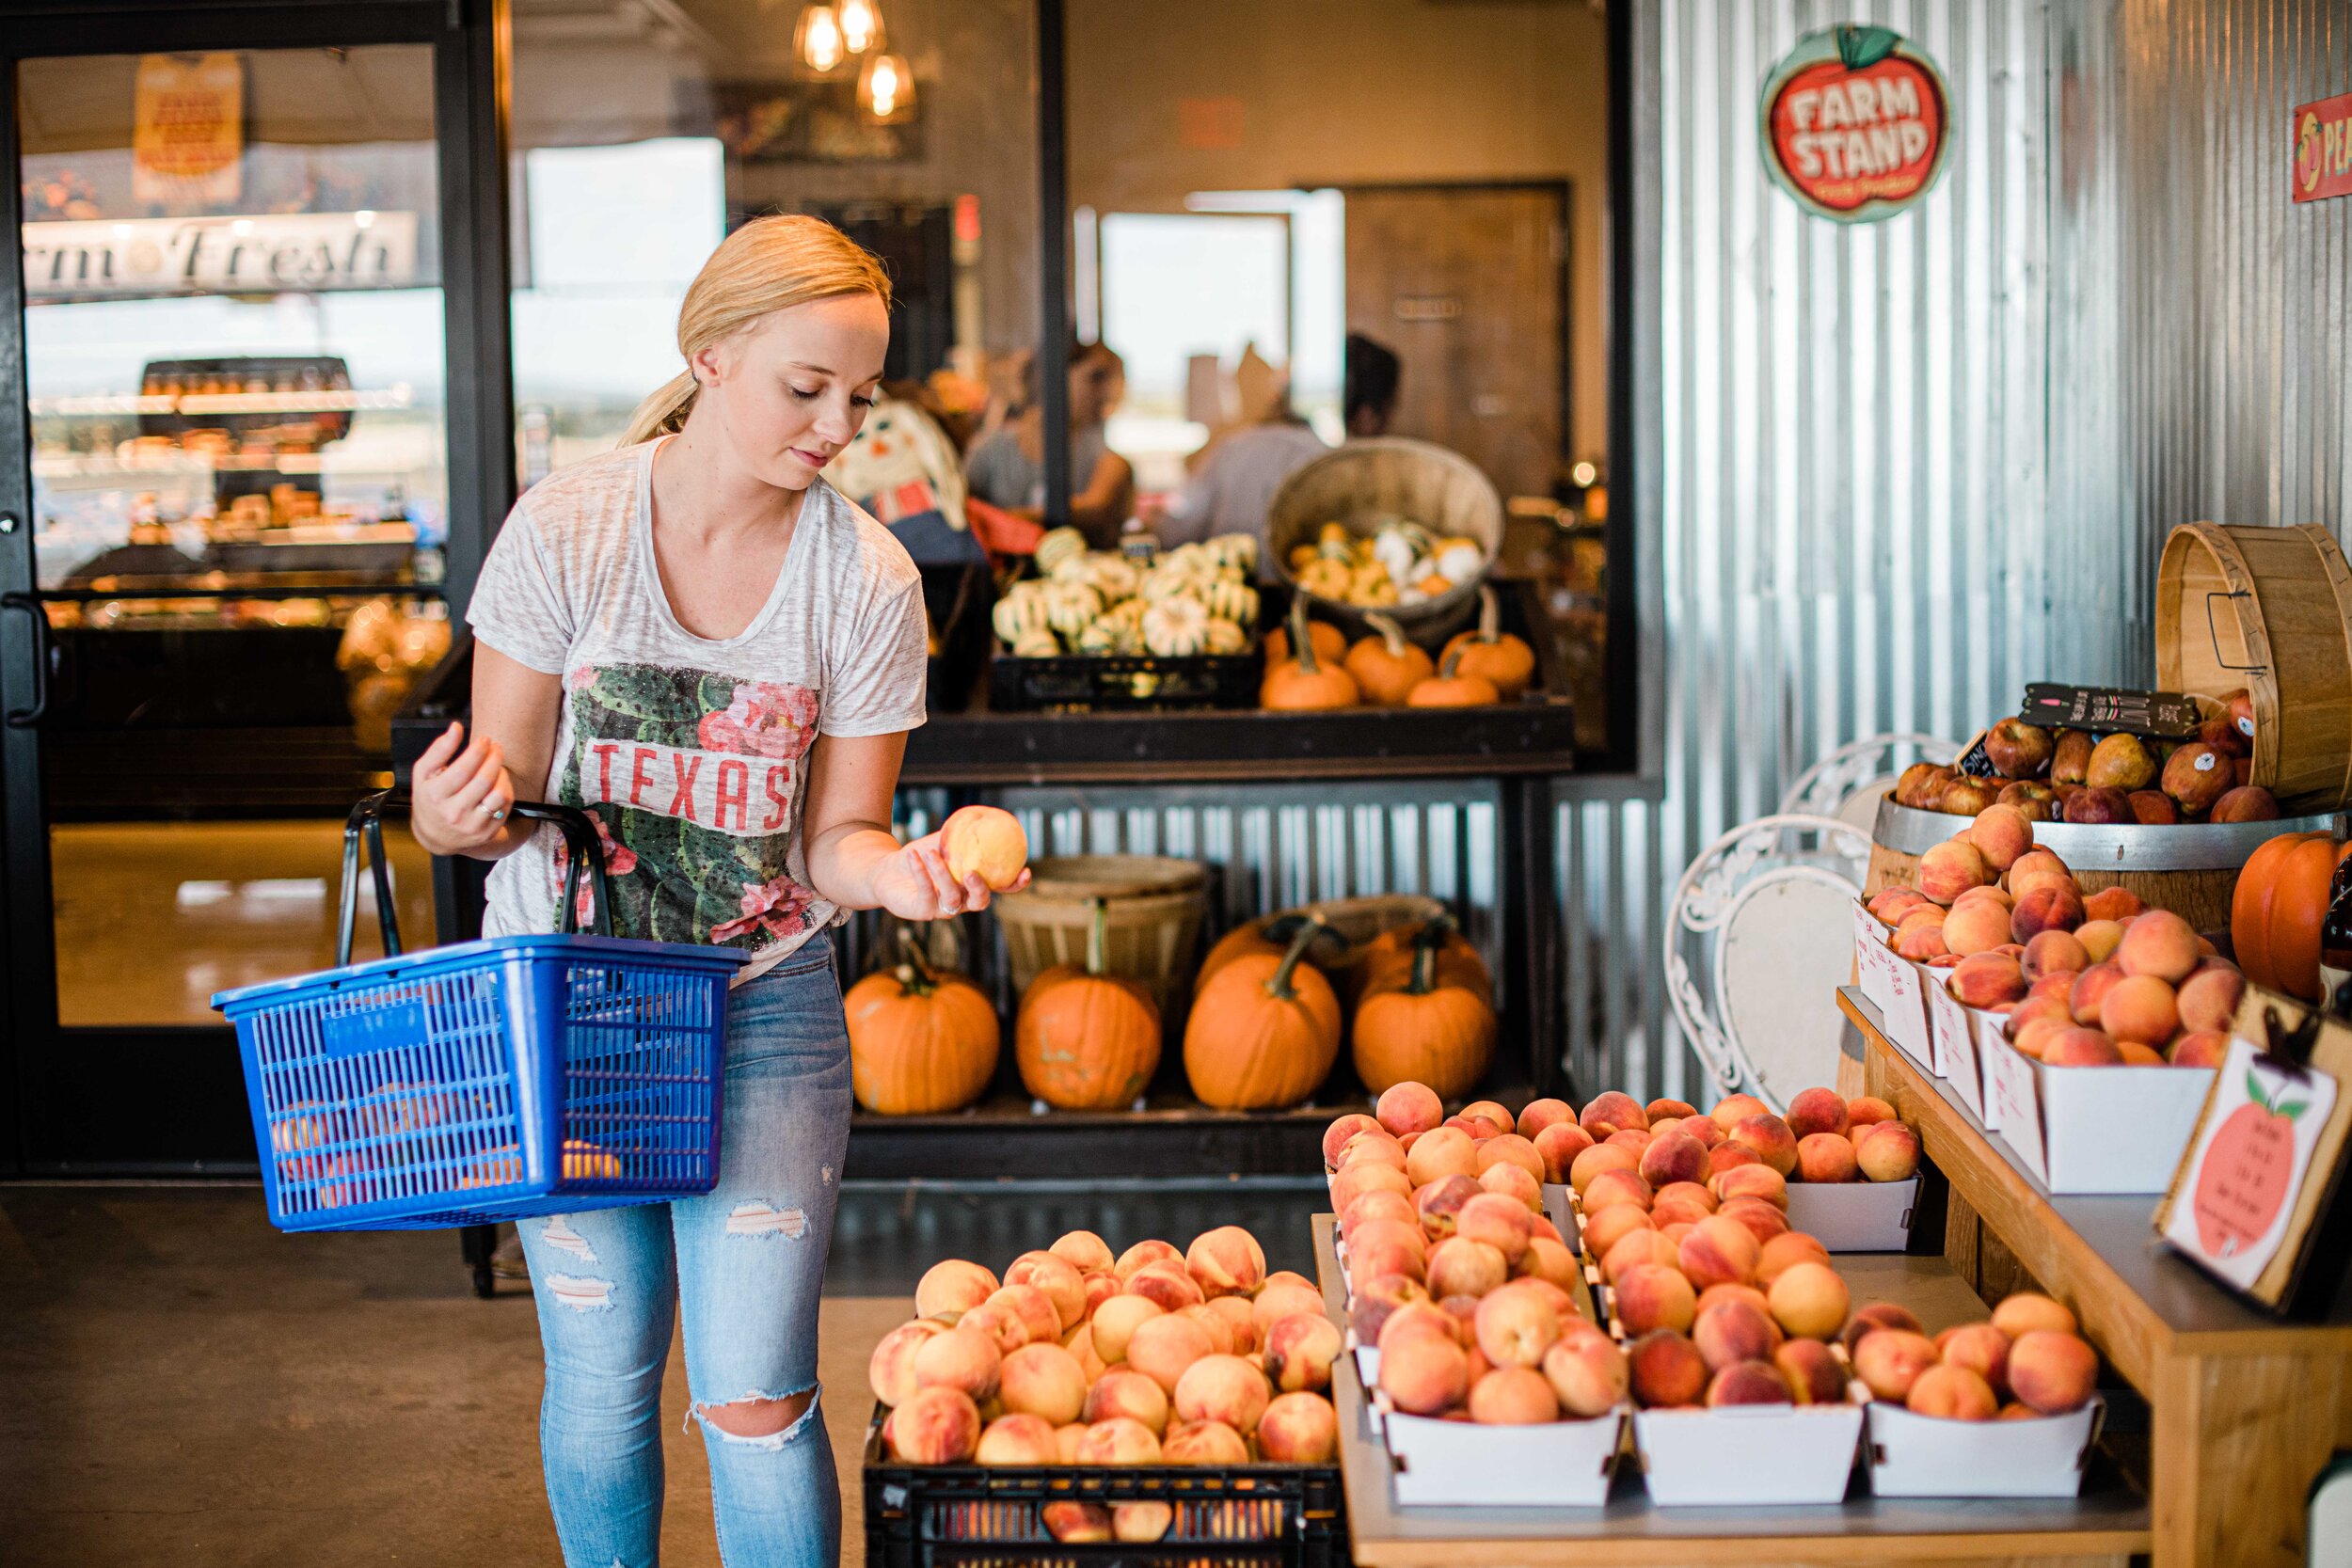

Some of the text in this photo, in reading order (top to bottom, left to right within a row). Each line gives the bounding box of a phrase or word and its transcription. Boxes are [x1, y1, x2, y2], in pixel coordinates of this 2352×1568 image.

[1789, 76, 1920, 131] FARM
[1790, 119, 1930, 180] STAND
[170, 224, 389, 282] Fresh
[593, 744, 791, 832] TEXAS
